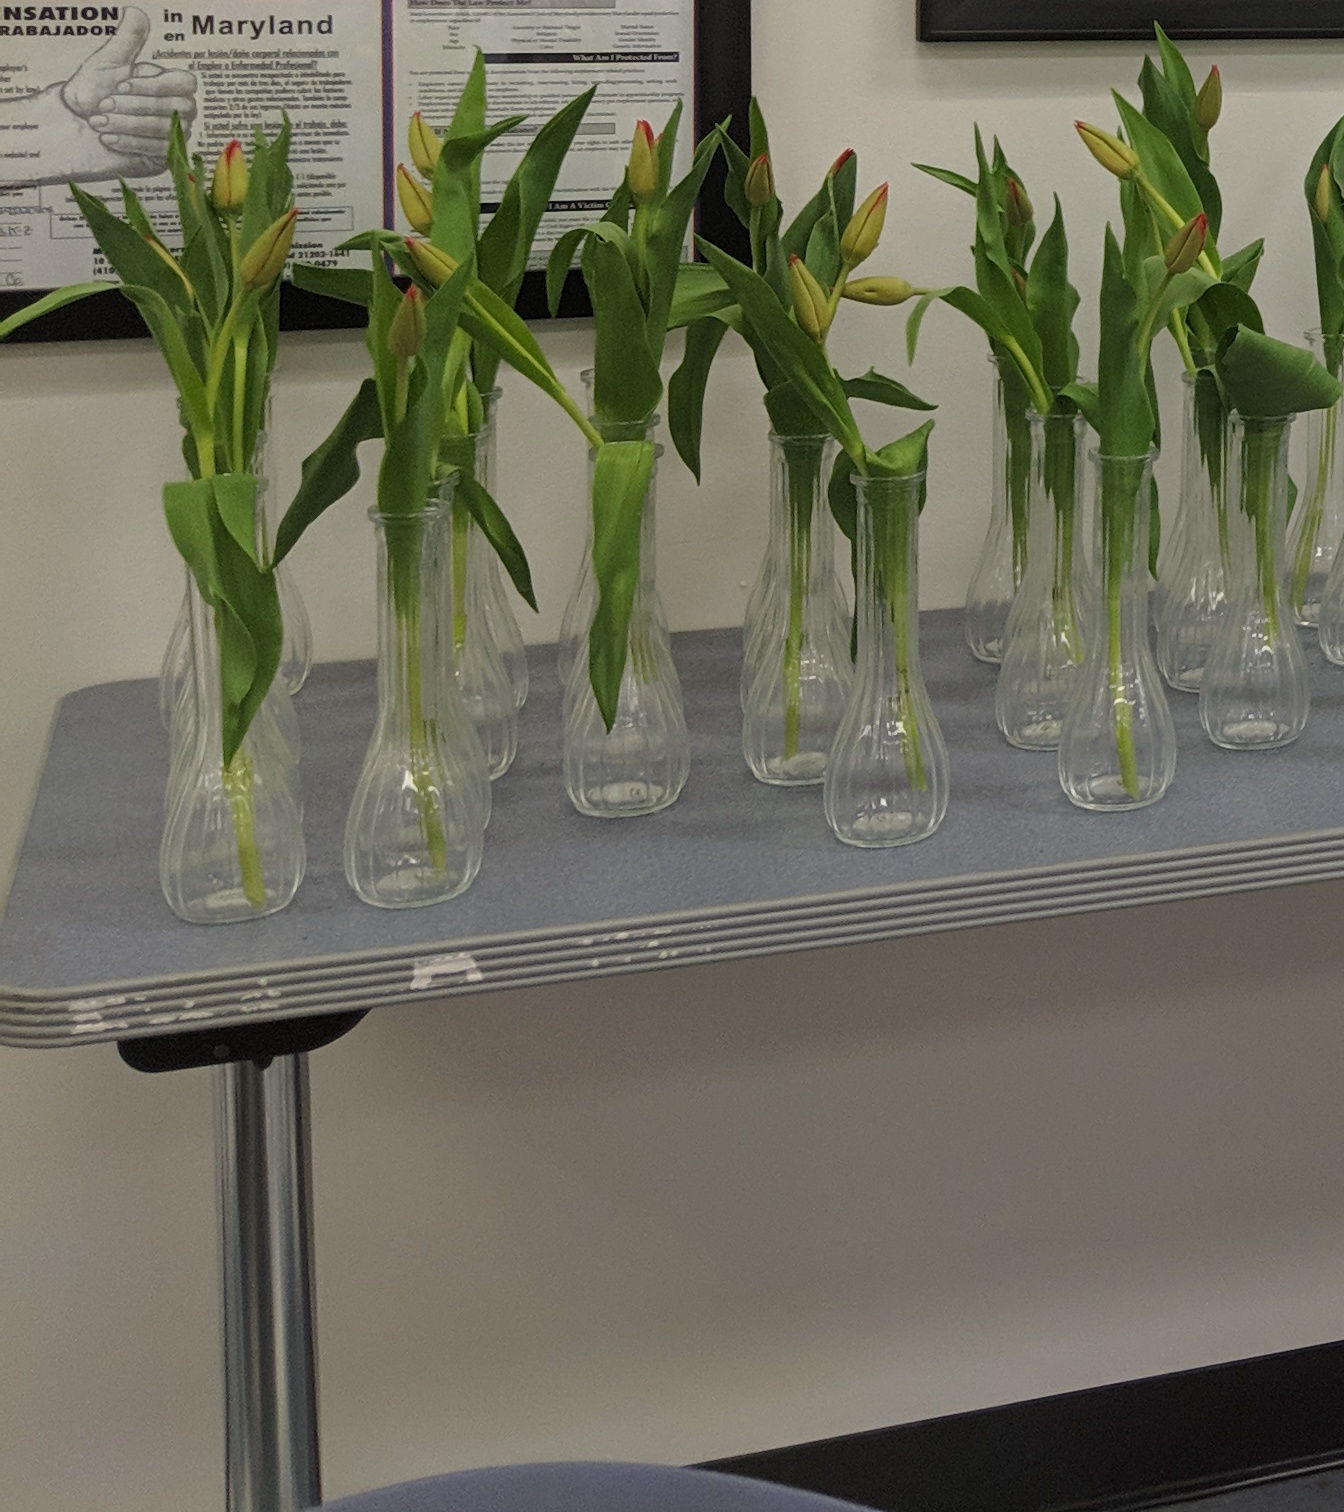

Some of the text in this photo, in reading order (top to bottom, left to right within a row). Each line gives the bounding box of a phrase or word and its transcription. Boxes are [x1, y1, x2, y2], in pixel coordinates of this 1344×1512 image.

[2, 6, 119, 21] NSATION
[164, 9, 183, 23] in
[0, 25, 117, 36] RABAJADOR
[192, 15, 333, 40] Maryland
[164, 31, 185, 42] en
